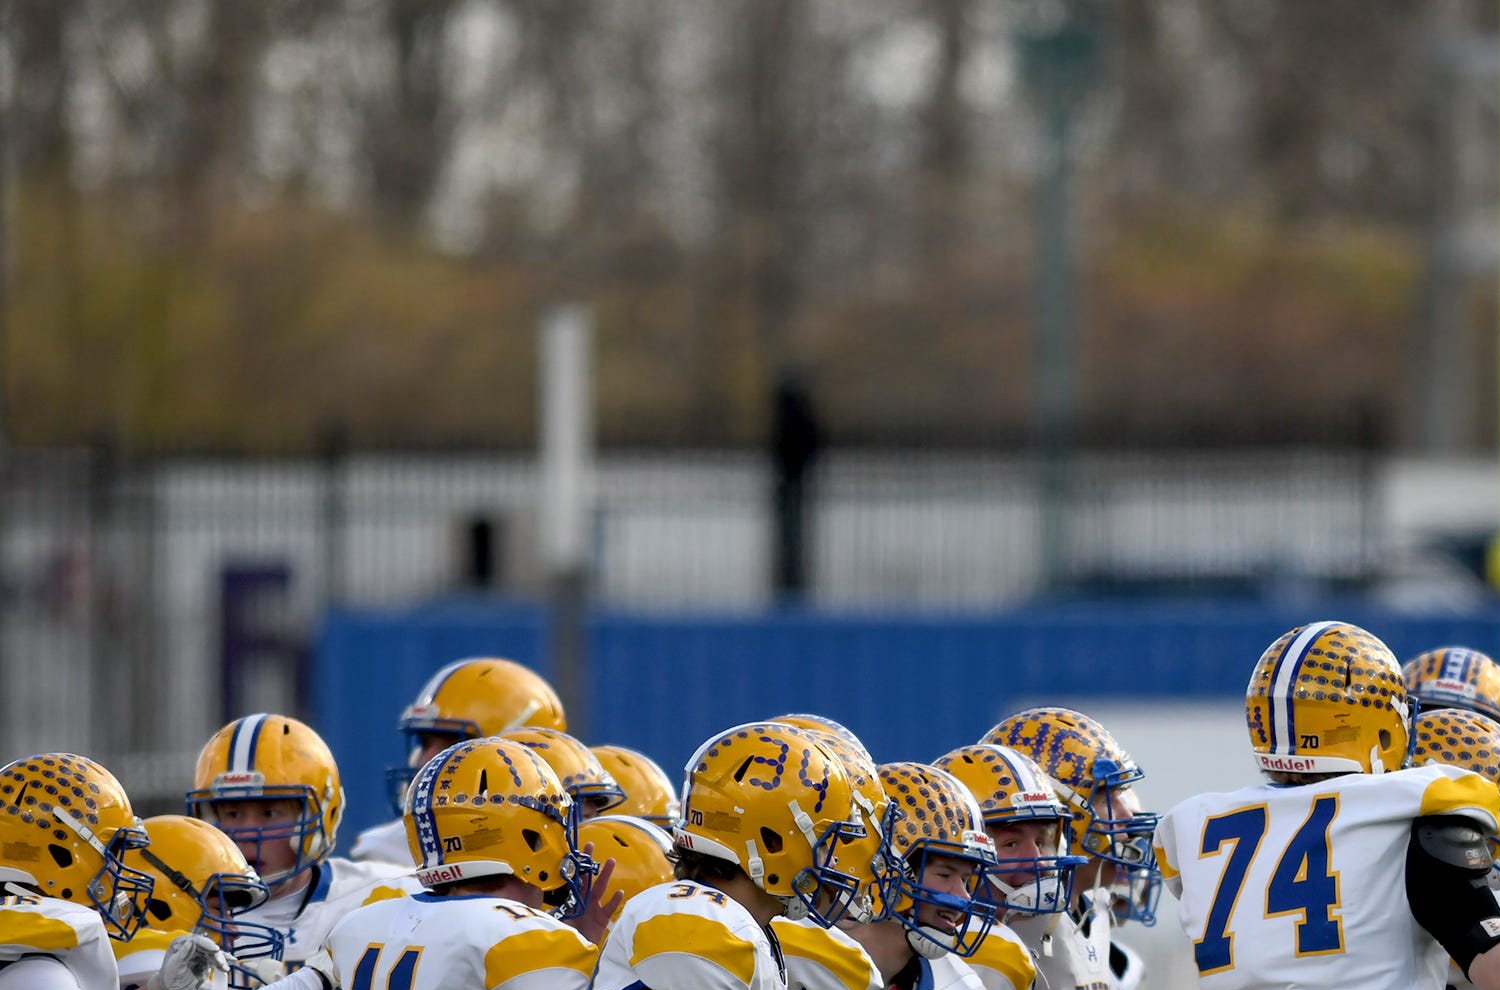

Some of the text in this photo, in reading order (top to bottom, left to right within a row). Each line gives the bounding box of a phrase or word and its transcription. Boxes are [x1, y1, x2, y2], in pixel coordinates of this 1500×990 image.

[1300, 735, 1320, 750] 70
[1260, 756, 1315, 771] Riddell
[690, 810, 703, 827] 70
[444, 836, 463, 853] 70
[1192, 792, 1346, 978] 74
